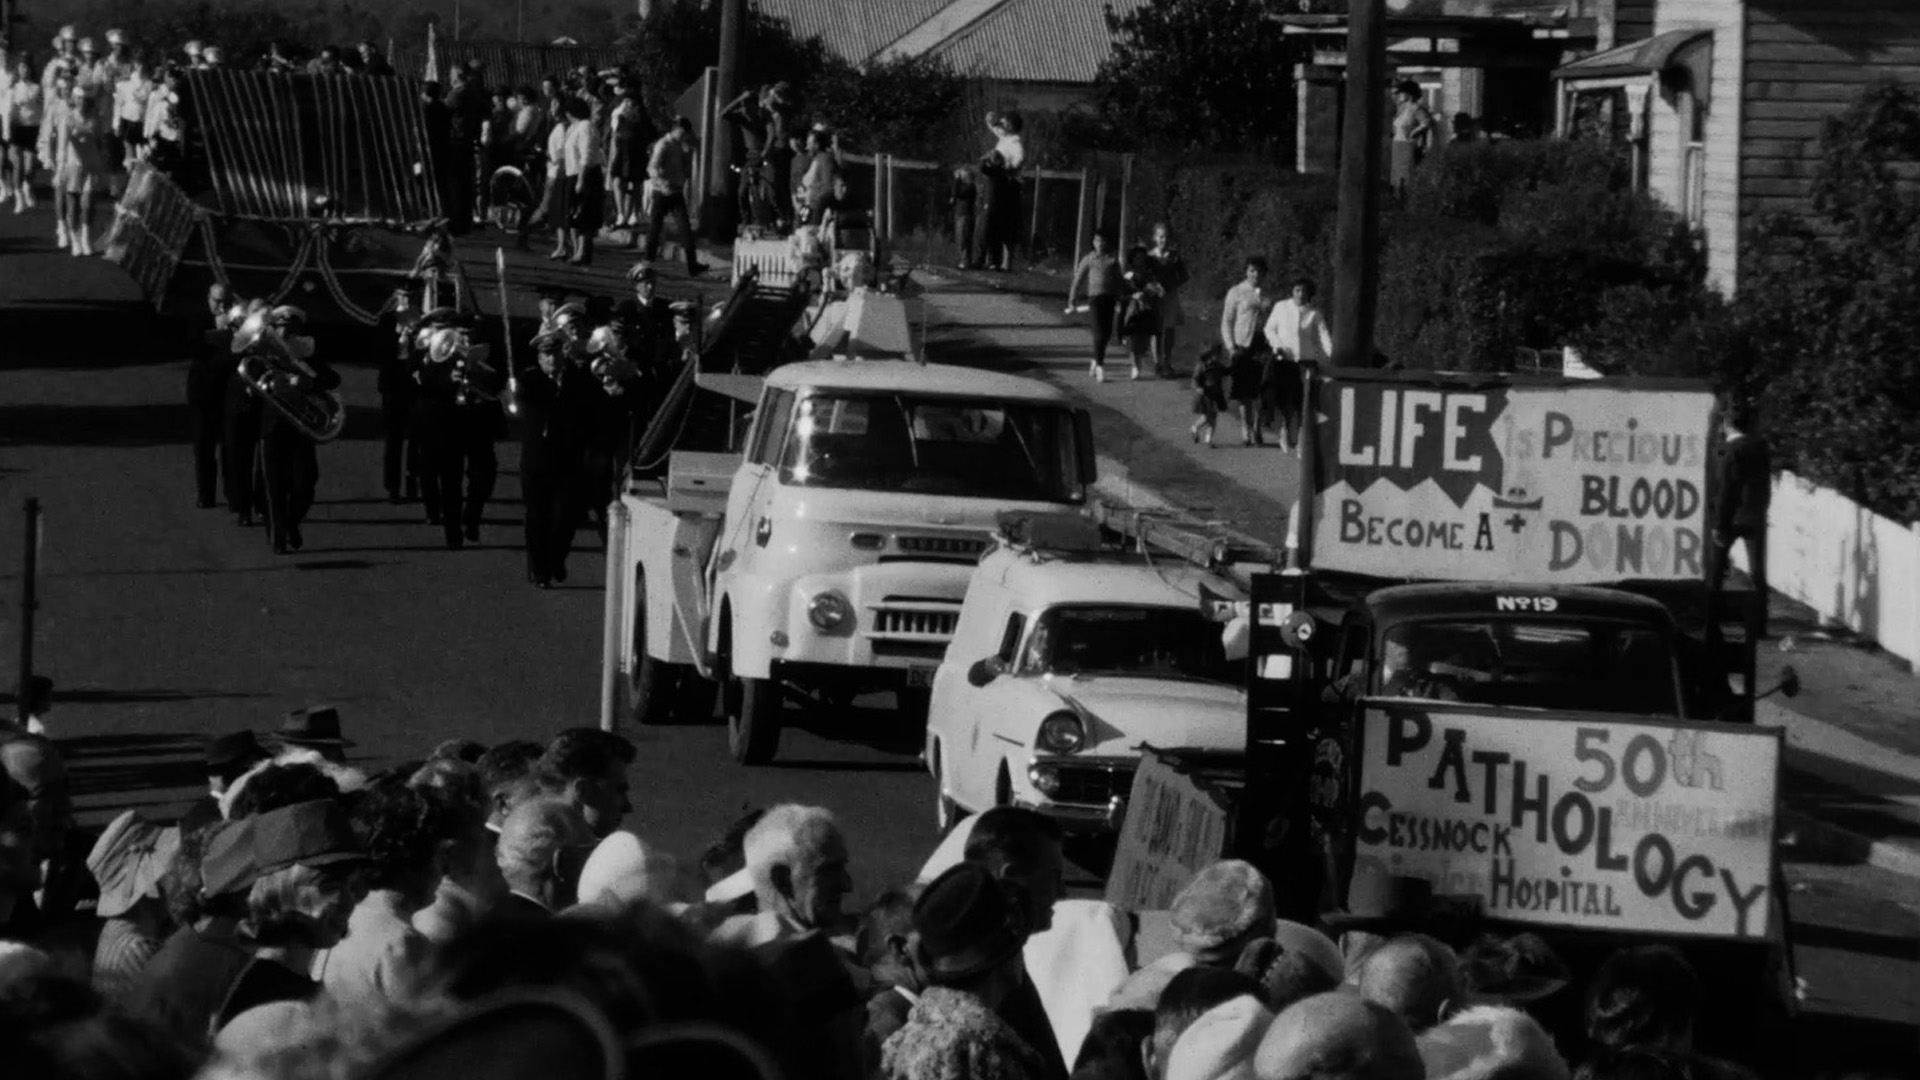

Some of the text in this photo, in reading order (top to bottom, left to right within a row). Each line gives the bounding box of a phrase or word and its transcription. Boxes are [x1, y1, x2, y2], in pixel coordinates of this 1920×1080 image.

[1338, 387, 1487, 472] LIFE
[1339, 500, 1495, 551] BECOME A
[1580, 473, 1699, 520] BLOOD
[1548, 520, 1701, 574] DONOR
[1572, 726, 1725, 798] 50th
[1357, 791, 1513, 856] CESSNOCK
[1384, 708, 1767, 936] PATHOLOGY
